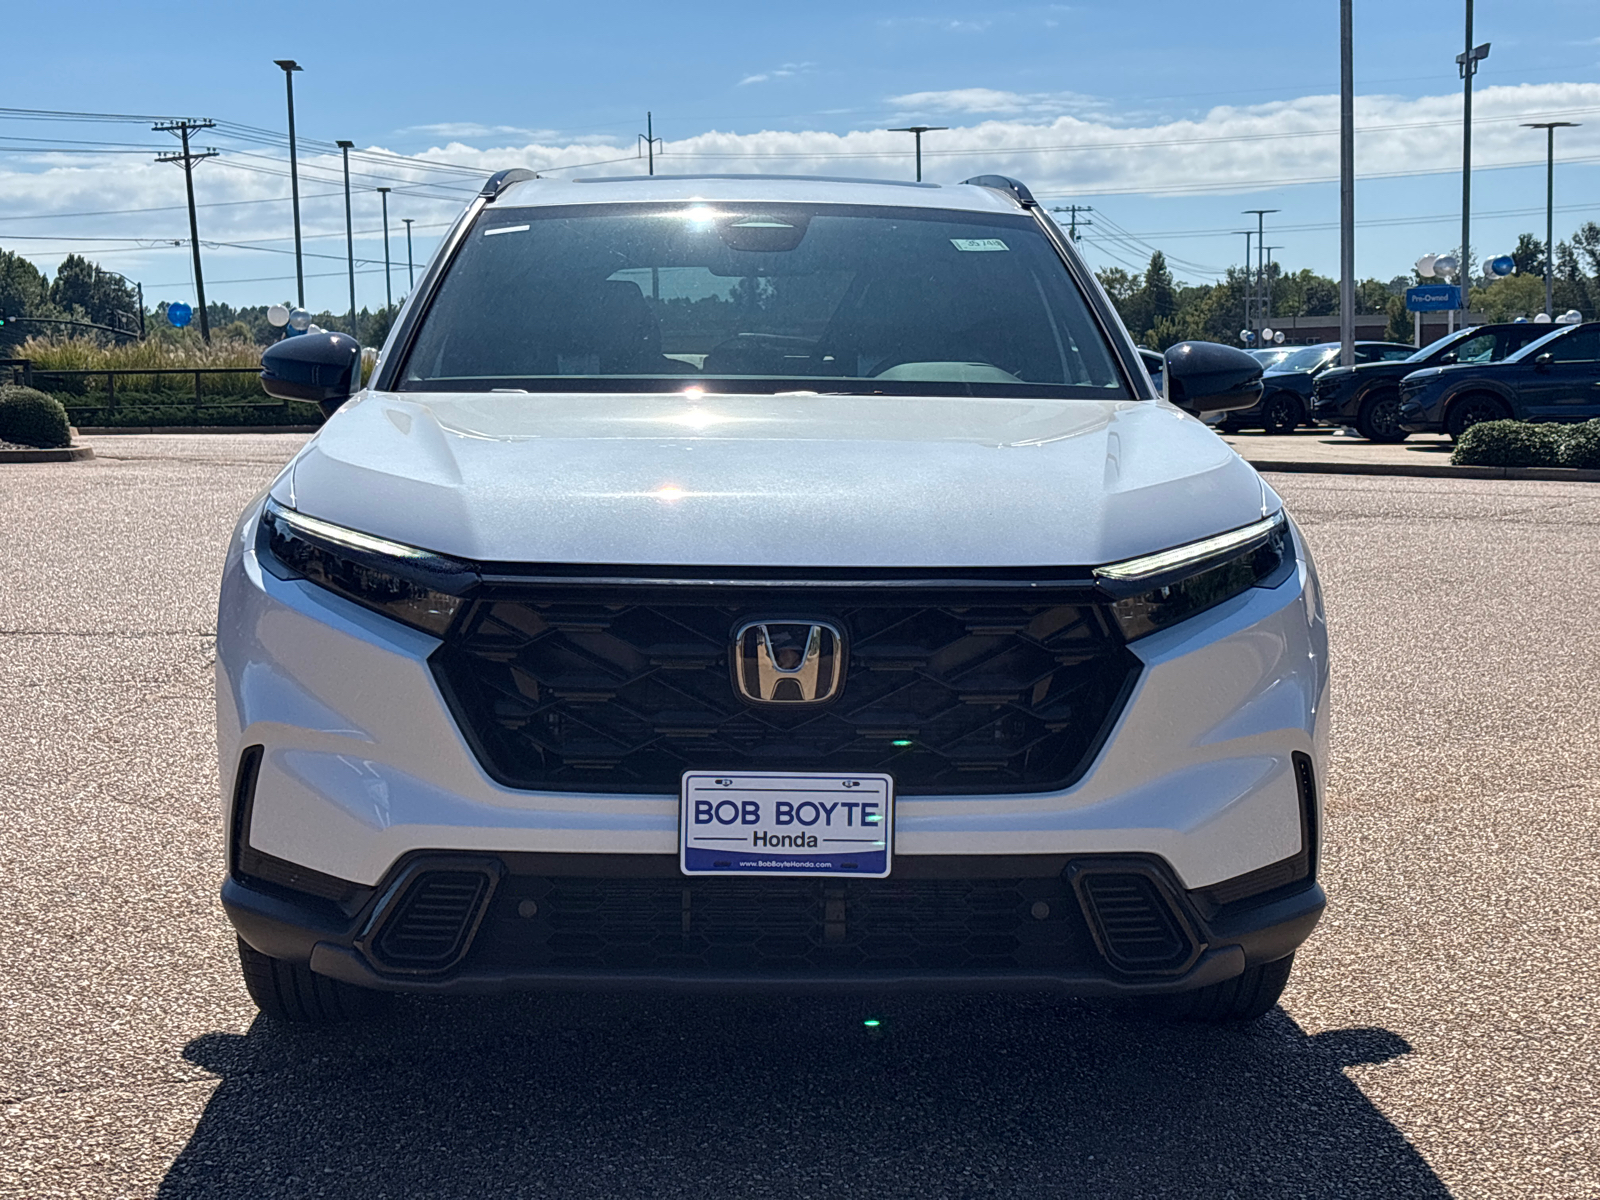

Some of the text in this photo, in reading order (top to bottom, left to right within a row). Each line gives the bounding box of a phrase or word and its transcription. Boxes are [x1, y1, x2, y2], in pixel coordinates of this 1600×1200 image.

[1411, 293, 1449, 302] Pre-Owned
[694, 800, 879, 827] BOB BOYTE
[753, 830, 818, 848] Honda
[739, 860, 832, 869] www.BobBoyteHonda.com
